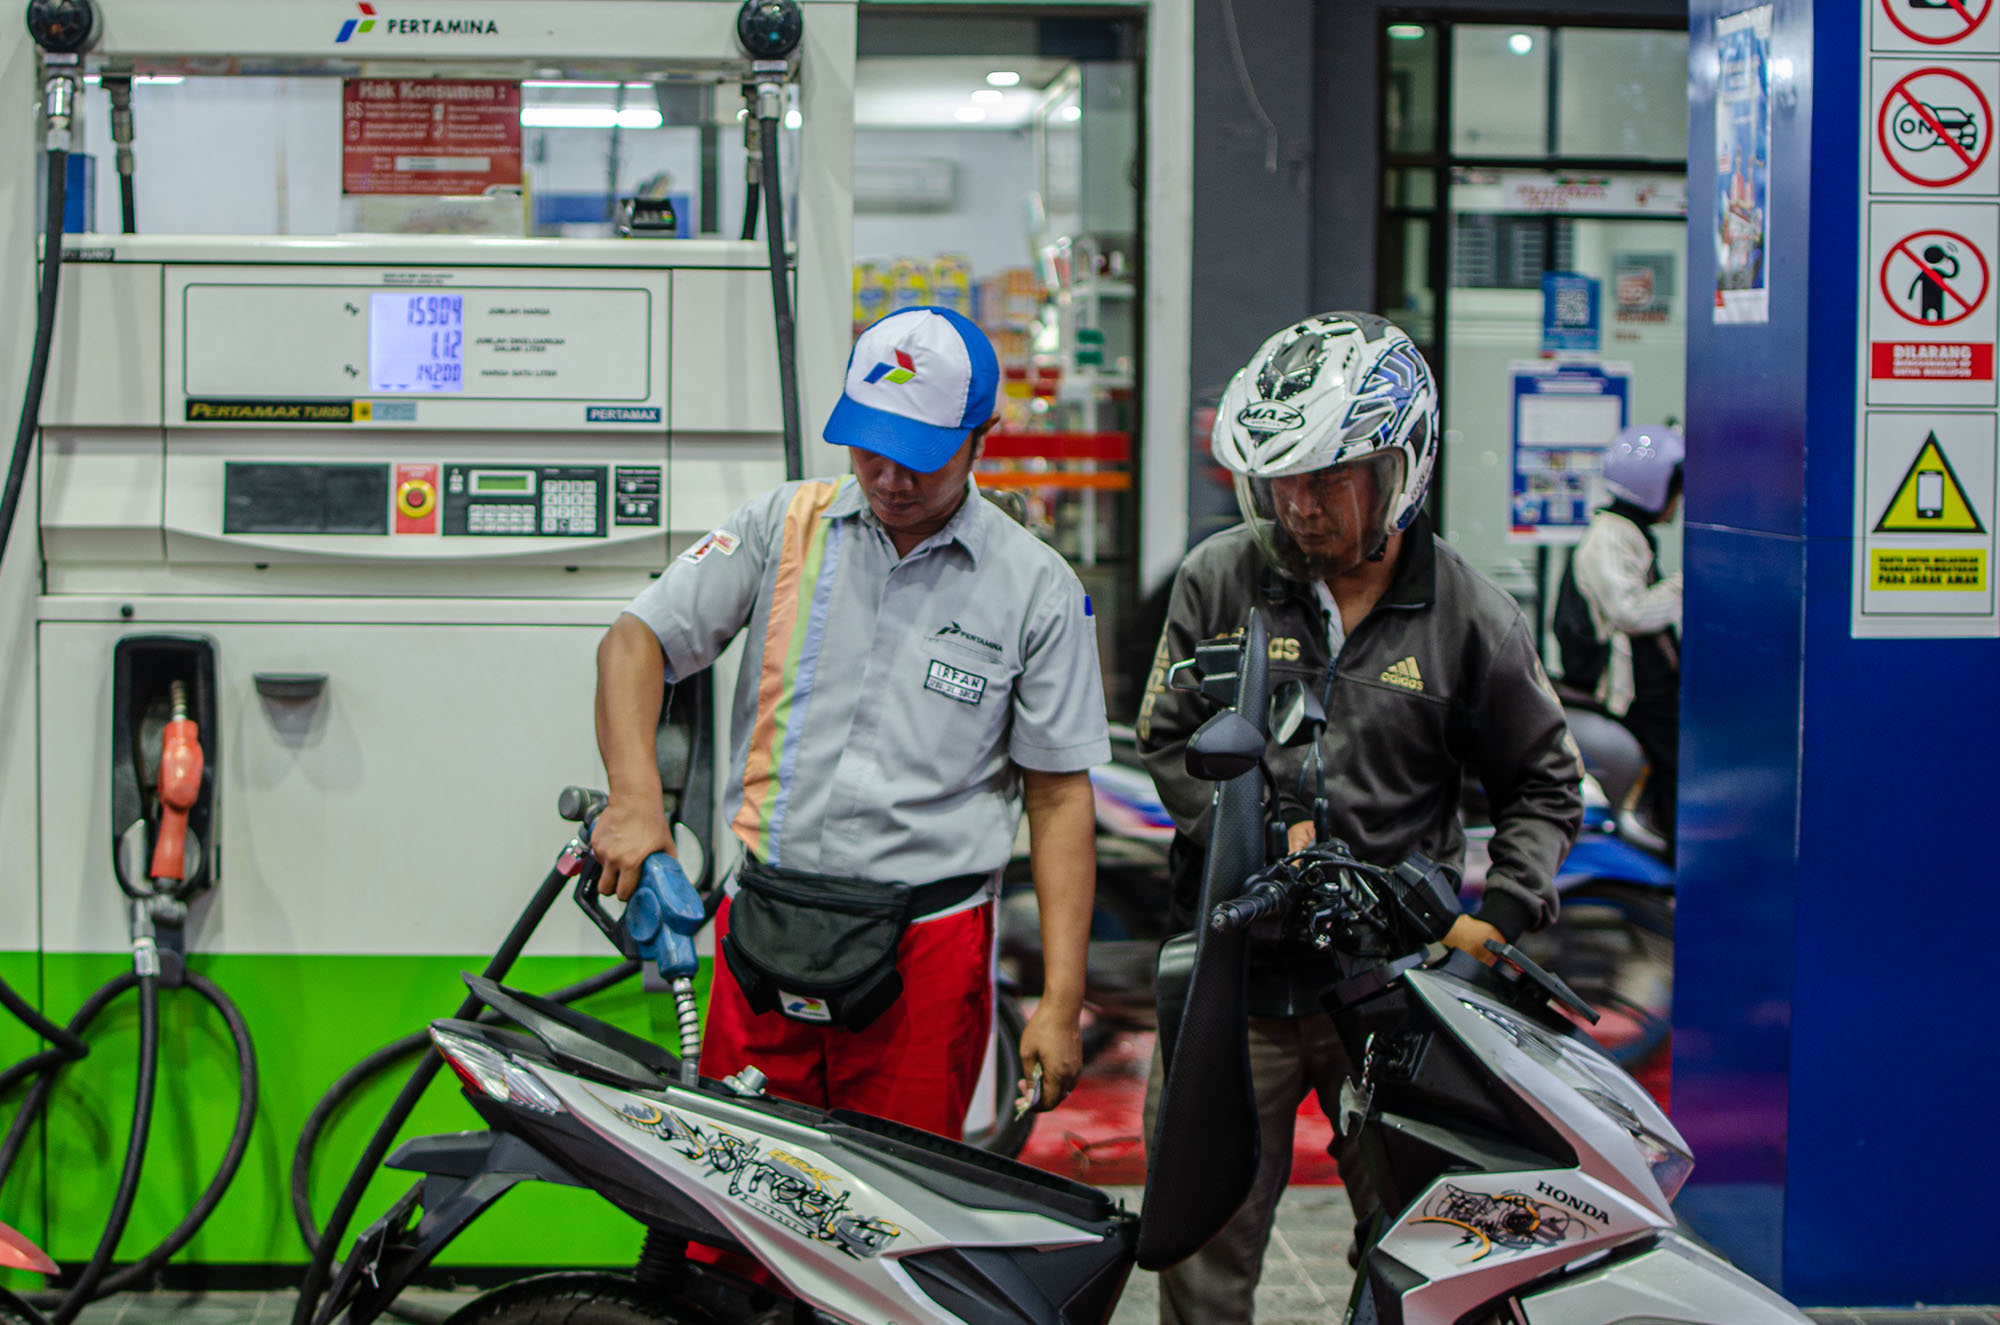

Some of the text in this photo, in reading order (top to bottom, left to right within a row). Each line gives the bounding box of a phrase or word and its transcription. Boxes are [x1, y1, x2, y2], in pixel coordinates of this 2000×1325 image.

[387, 19, 499, 34] PERTAMINA
[358, 81, 397, 99] Hak
[401, 82, 495, 100] Konsumen
[1900, 119, 1933, 134] ON
[407, 297, 463, 325] 15904
[1893, 344, 1972, 359] DILARANG
[416, 363, 461, 382] 14200
[189, 403, 350, 418] PERTAMAX TURBO
[589, 409, 657, 421] PERTAMAX
[1241, 407, 1301, 425] MAZ
[1879, 575, 1979, 584] PADA JARAK AMAN
[935, 664, 981, 689] IRFAN
[1380, 671, 1424, 692] adidas
[709, 1132, 852, 1242] Street
[1536, 1181, 1610, 1225] HONDA
